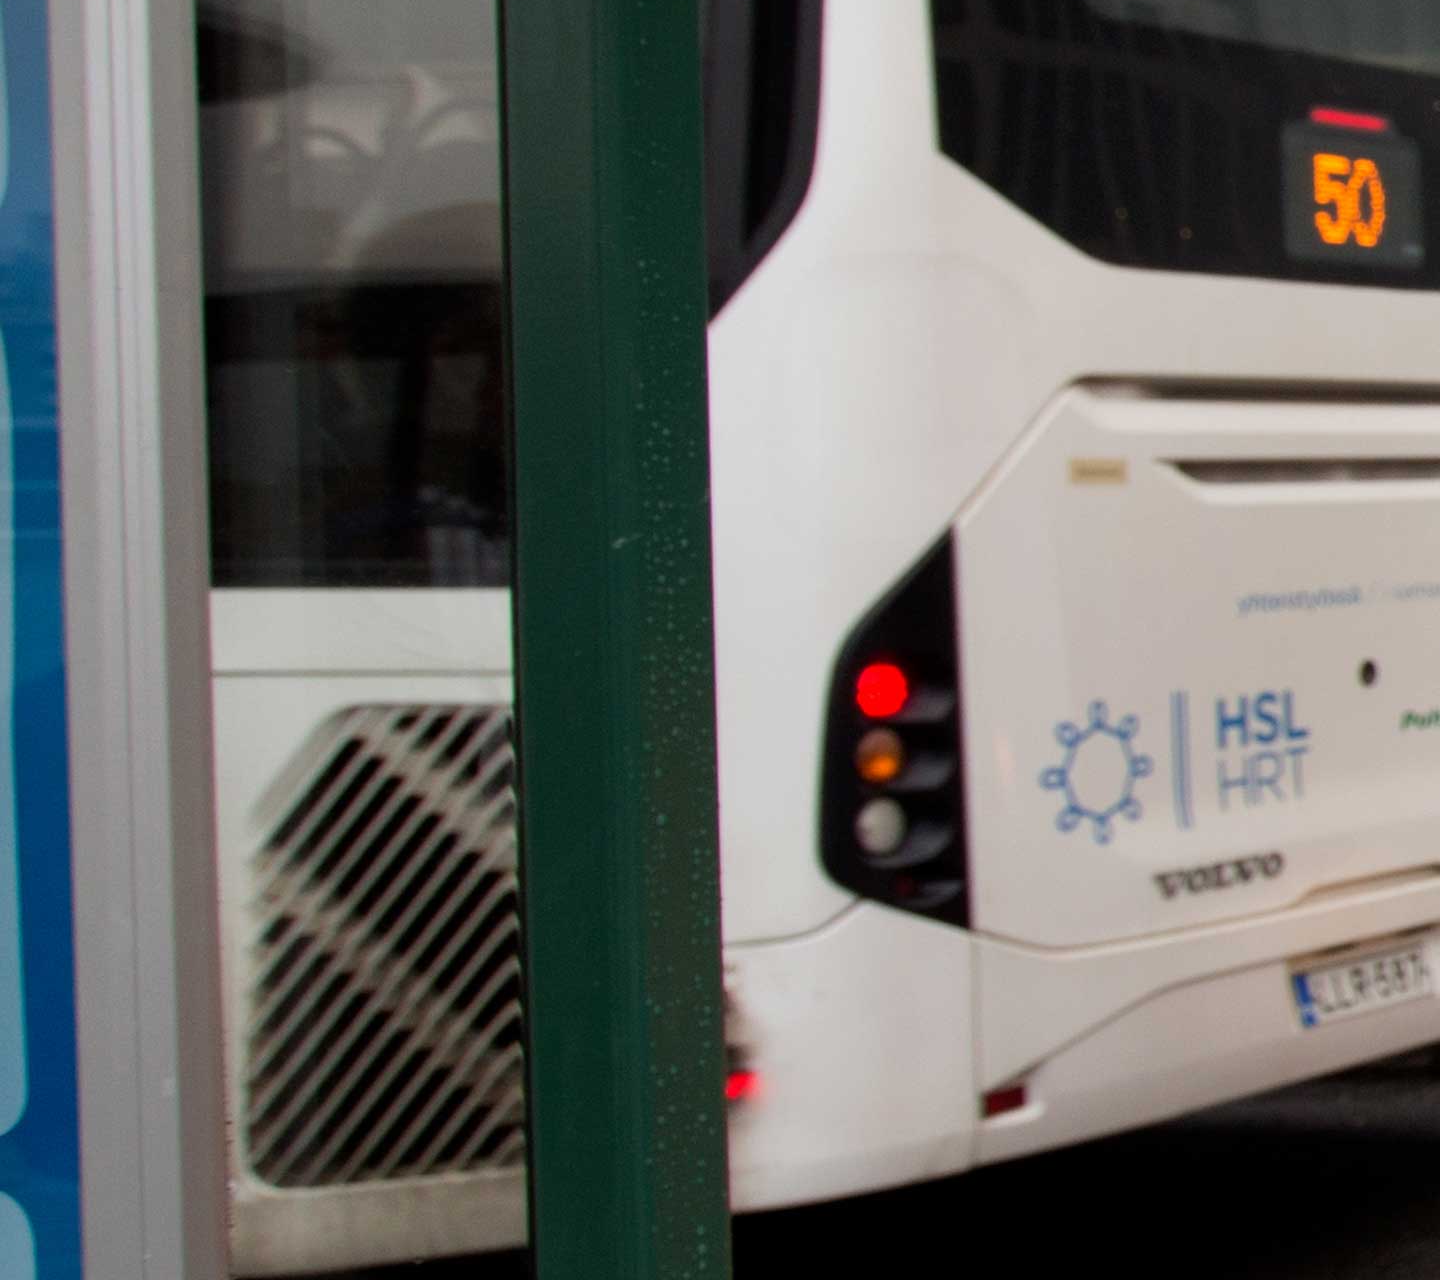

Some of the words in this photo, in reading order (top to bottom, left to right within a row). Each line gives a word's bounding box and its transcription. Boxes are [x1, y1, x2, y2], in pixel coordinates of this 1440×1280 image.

[1313, 153, 1386, 247] 50
[1215, 689, 1310, 750] HSL
[1216, 745, 1309, 811] HRT
[1152, 851, 1286, 901] VOLVO
